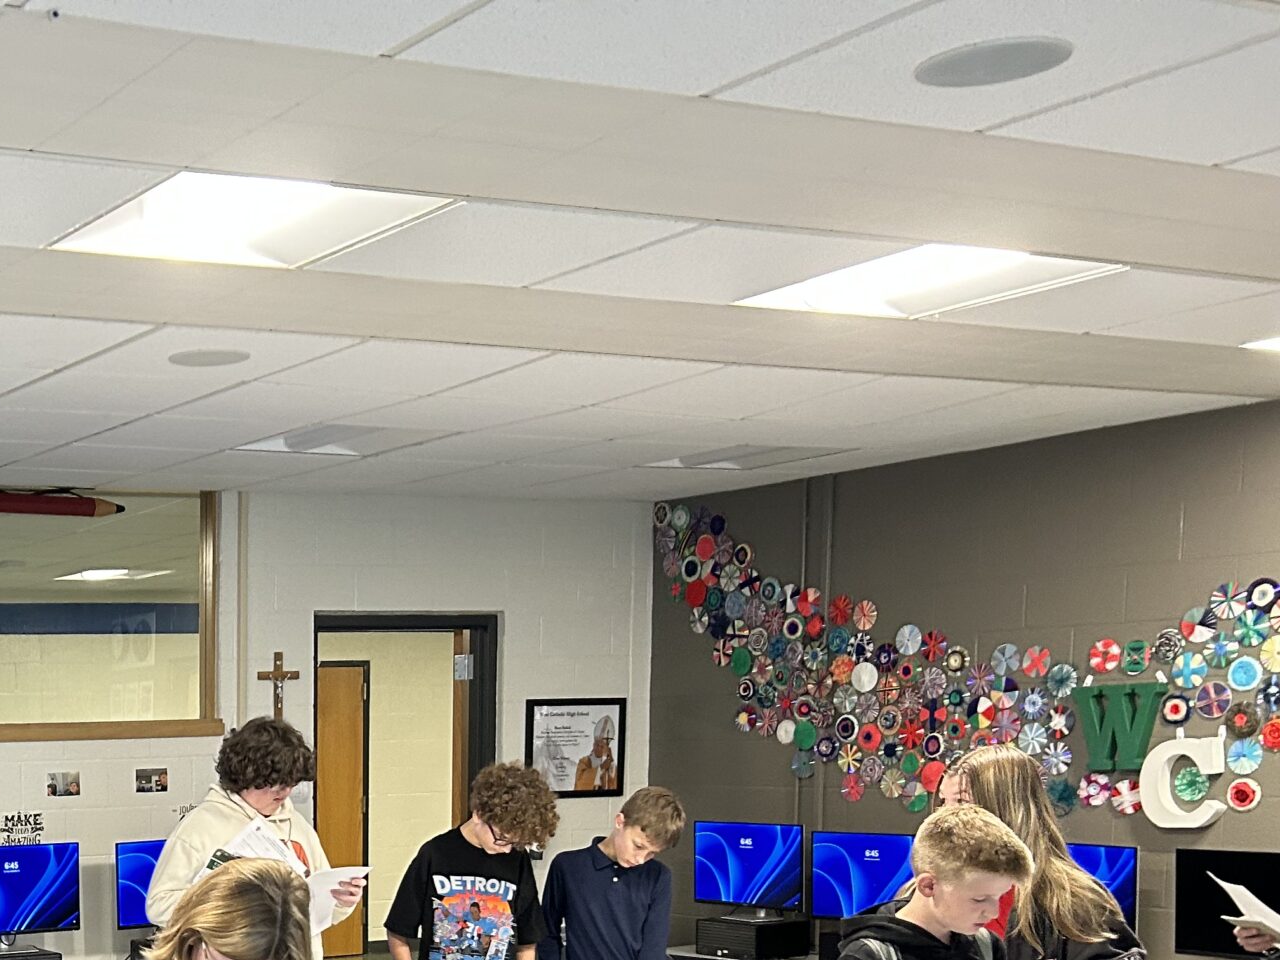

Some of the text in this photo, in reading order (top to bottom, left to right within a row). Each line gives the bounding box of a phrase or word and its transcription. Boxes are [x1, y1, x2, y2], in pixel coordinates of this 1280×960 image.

[1071, 682, 1169, 773] W
[1140, 737, 1228, 829] C
[4, 812, 43, 828] MAKE
[4, 861, 19, 870] 6:45
[432, 875, 518, 901] DETROIT
